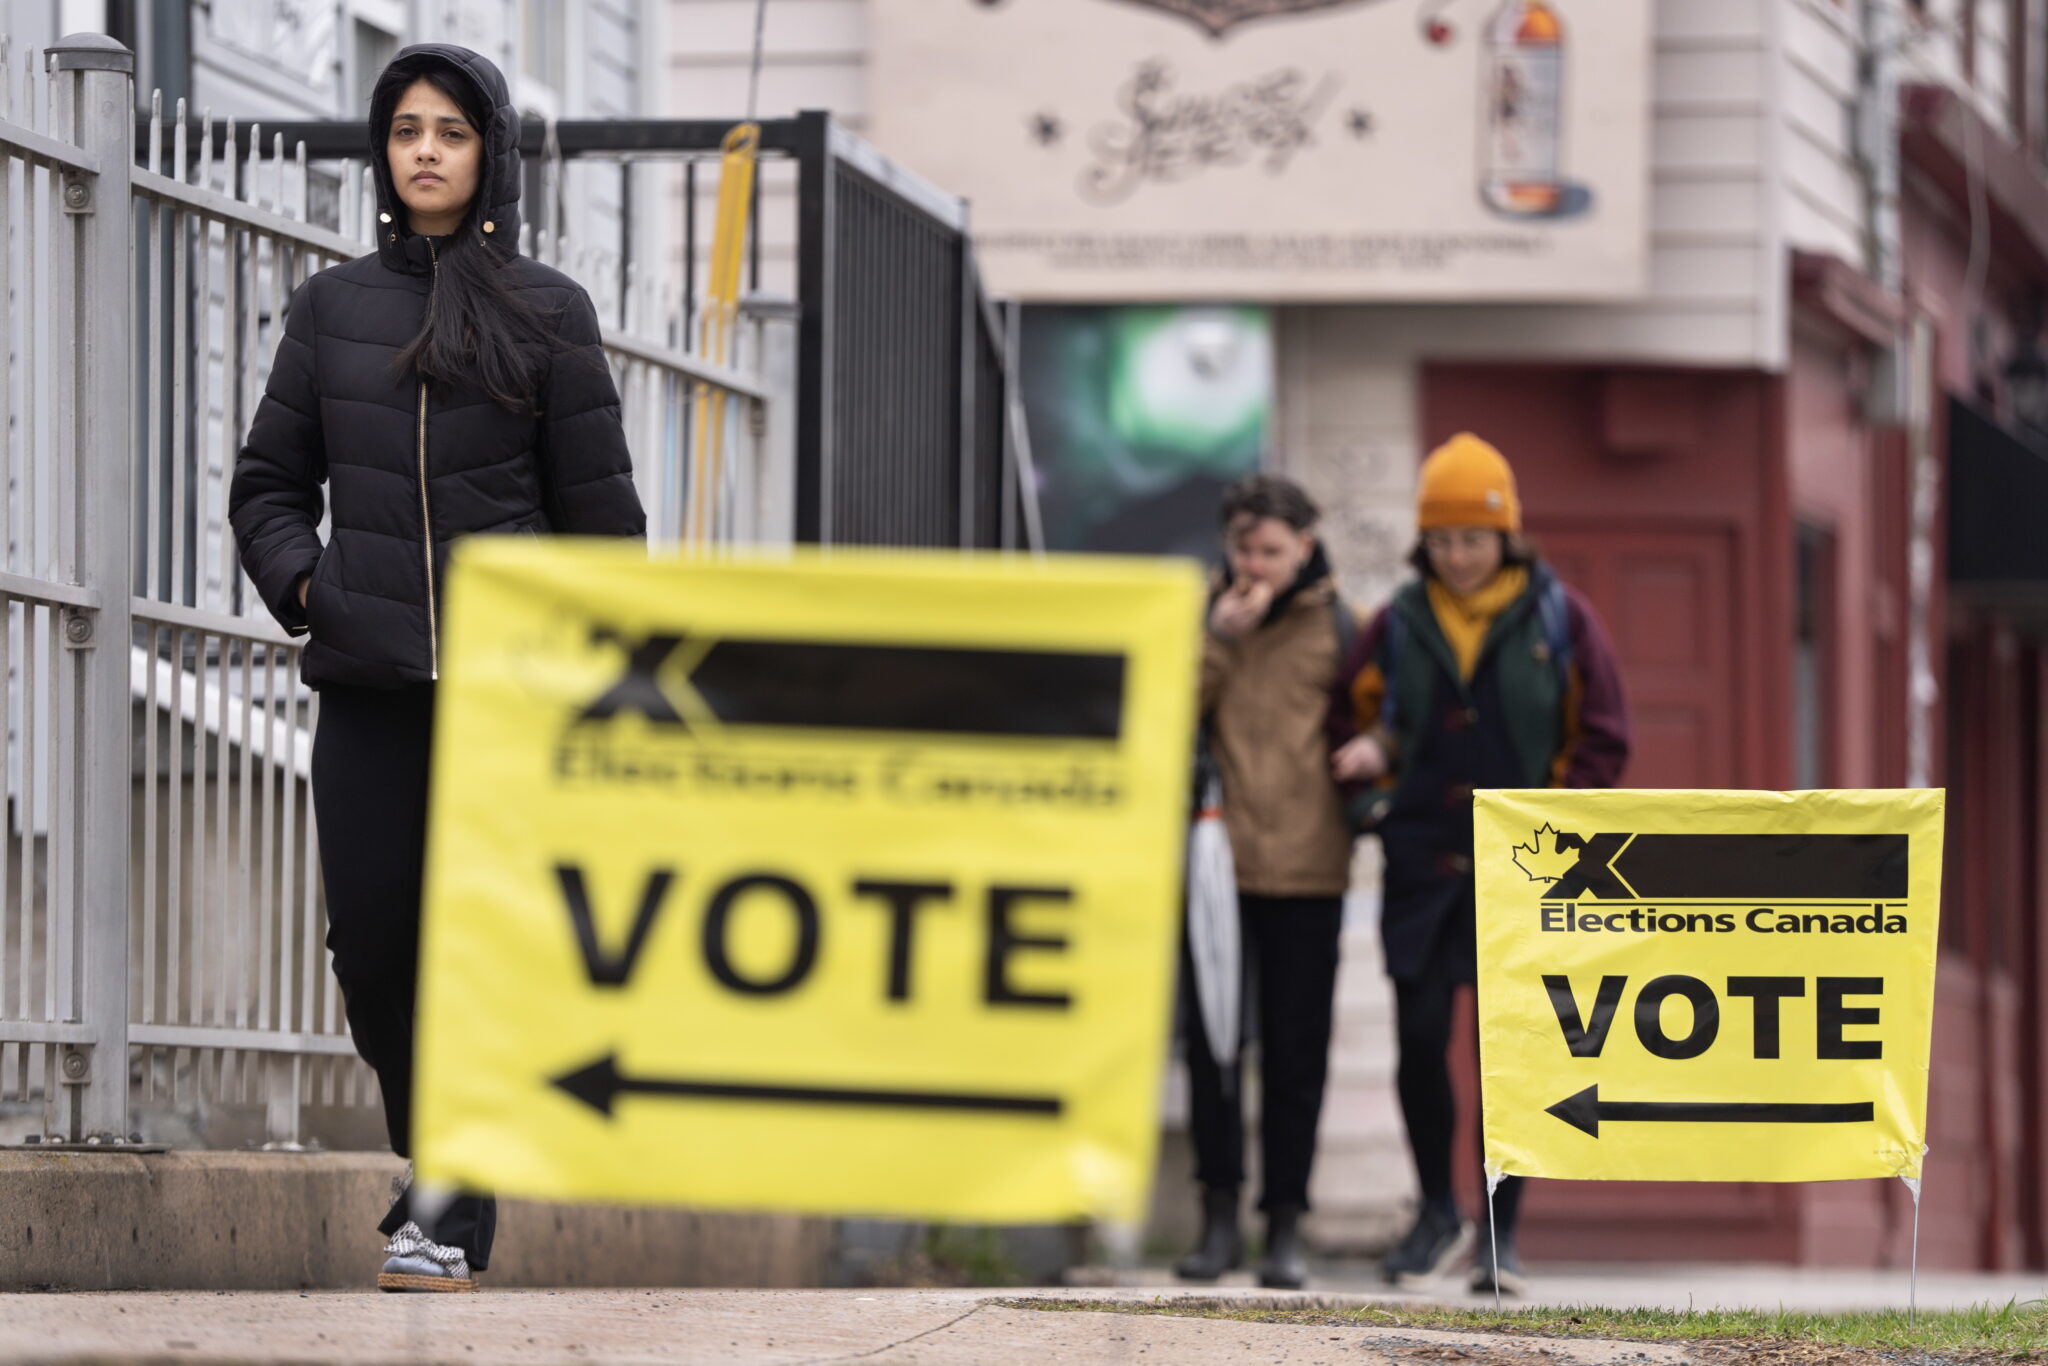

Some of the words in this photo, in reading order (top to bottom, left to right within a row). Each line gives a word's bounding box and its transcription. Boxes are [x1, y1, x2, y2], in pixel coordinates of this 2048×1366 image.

[552, 862, 1077, 1011] VOTE
[1540, 902, 1736, 933] Elections
[1745, 903, 1908, 934] Canada
[1541, 974, 1884, 1060] VOTE
